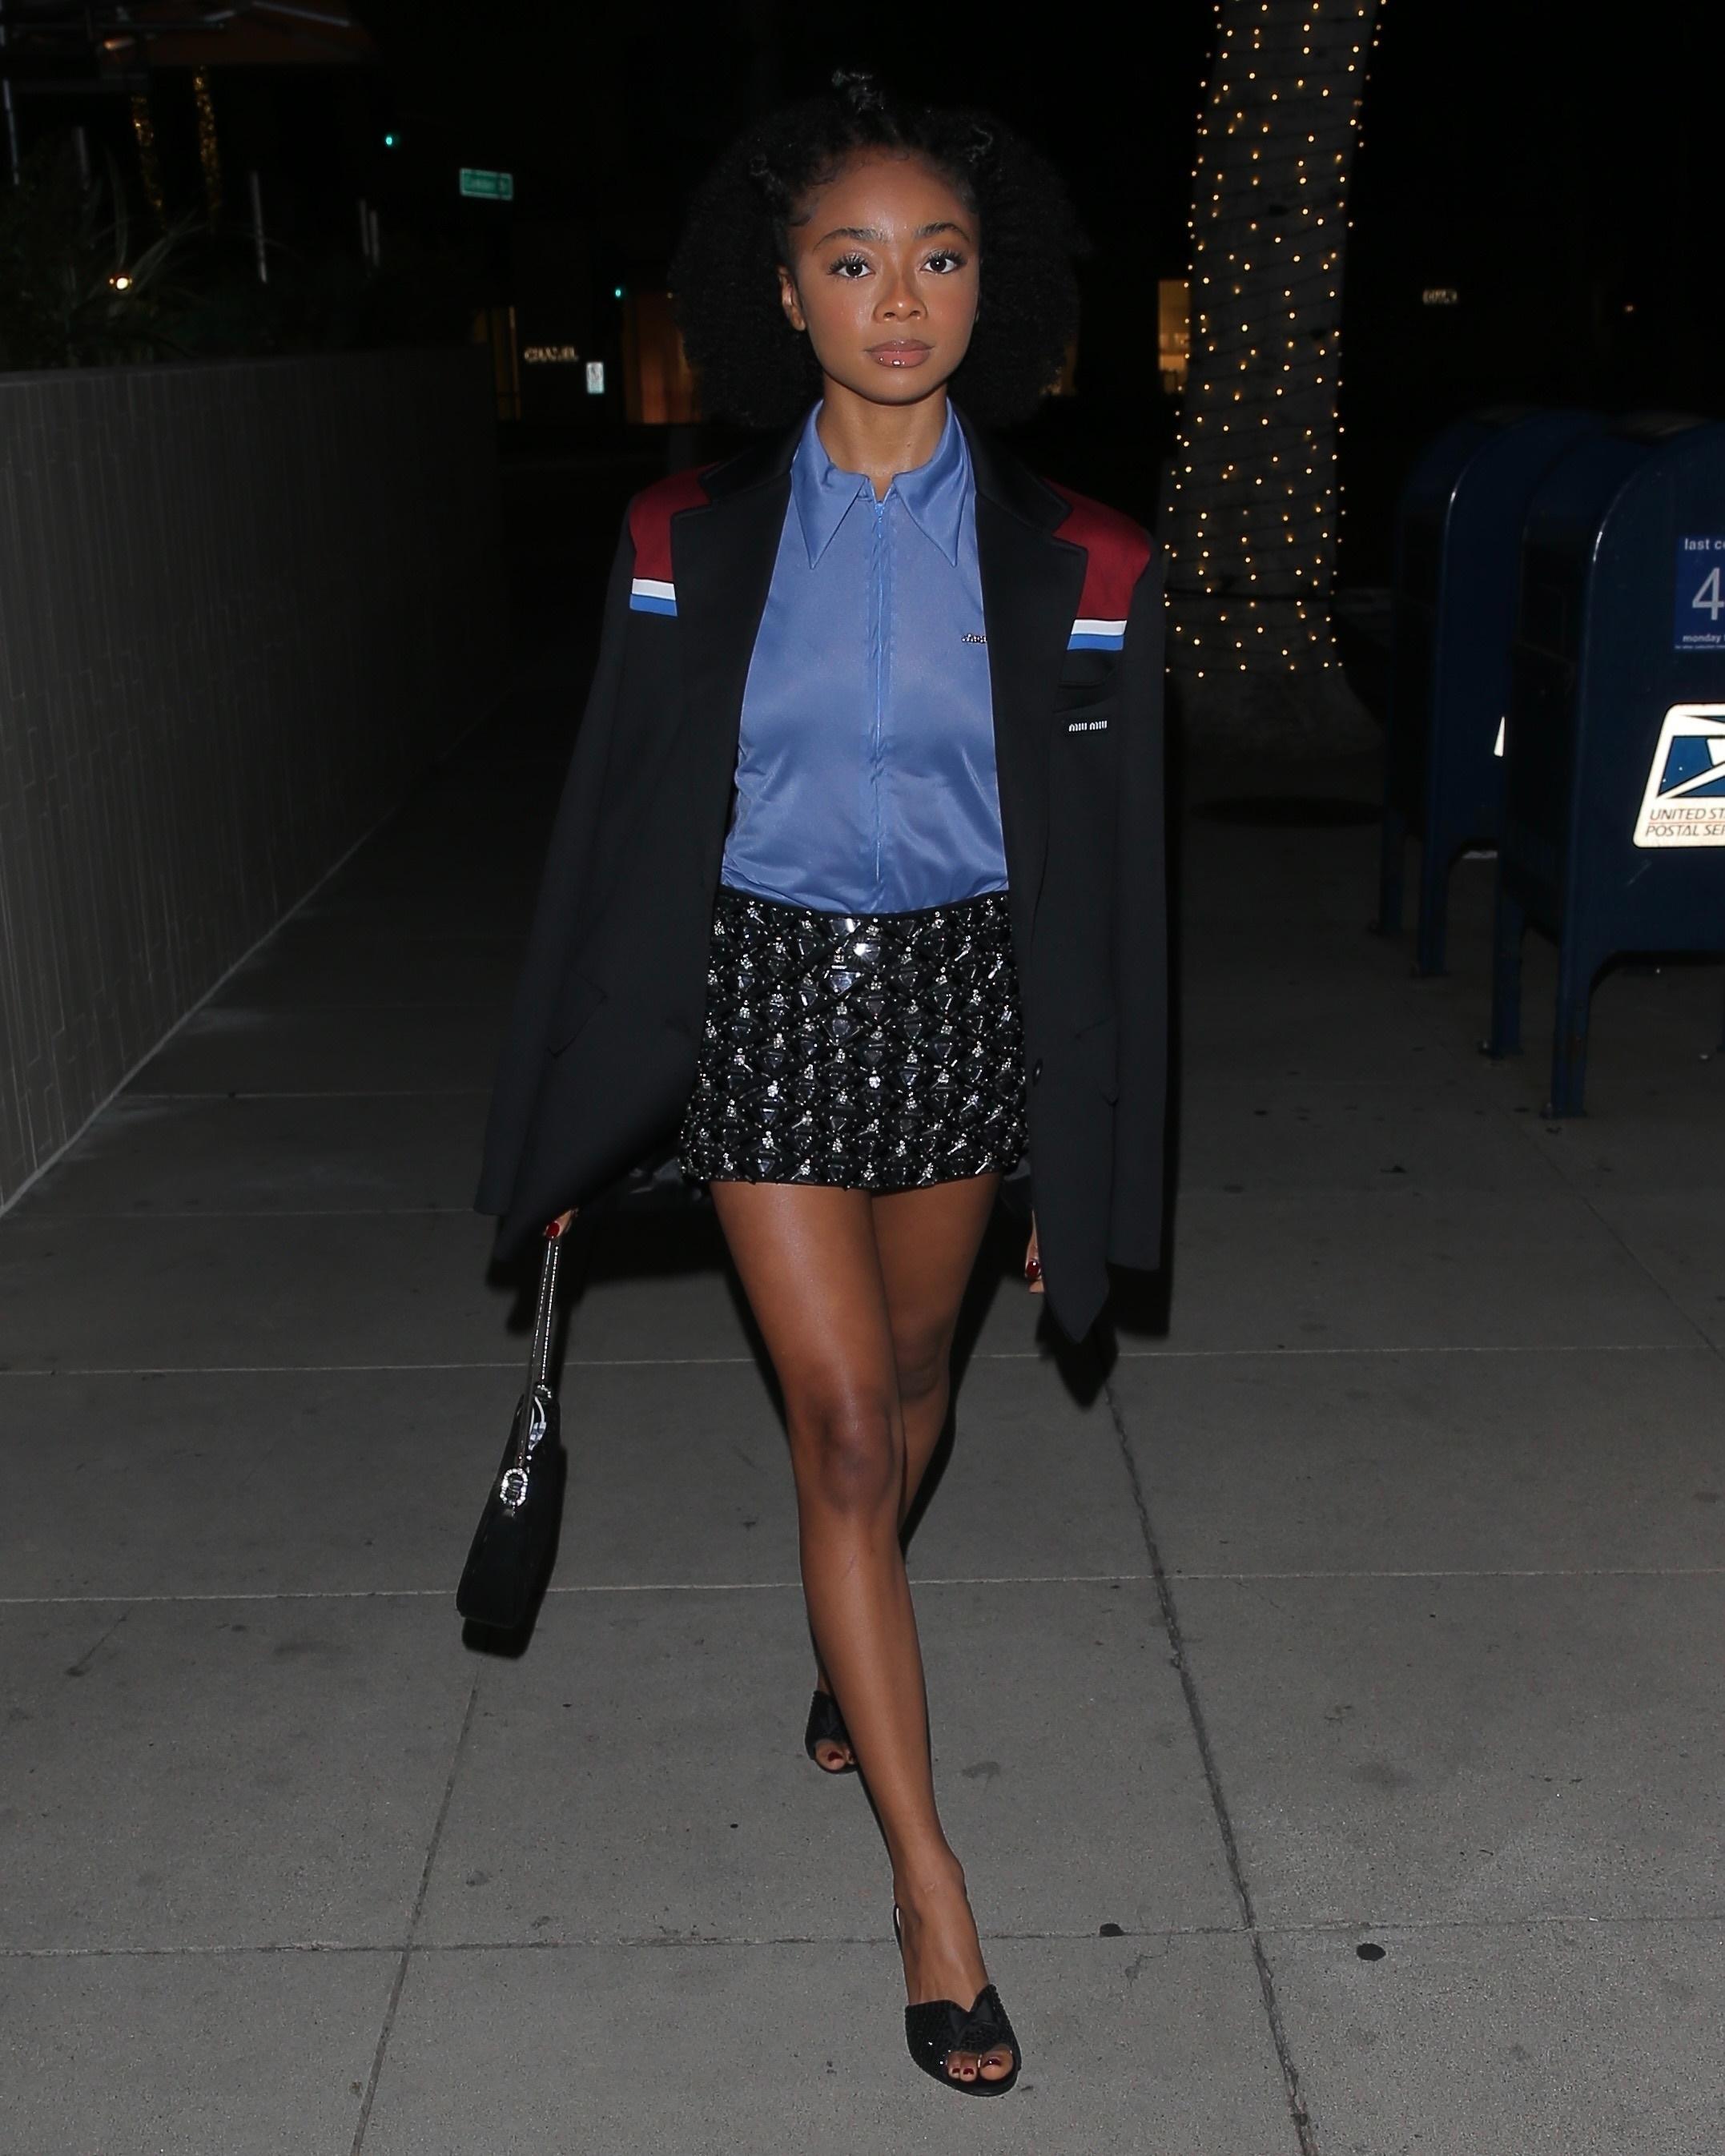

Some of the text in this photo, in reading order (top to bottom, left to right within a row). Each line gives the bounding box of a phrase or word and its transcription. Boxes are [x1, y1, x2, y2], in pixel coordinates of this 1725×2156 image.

[1684, 537, 1711, 551] last
[1691, 566, 1725, 621] 4
[1682, 633, 1722, 644] monday
[1650, 807, 1725, 820] UNITED ST
[1645, 824, 1699, 837] POSTAL
